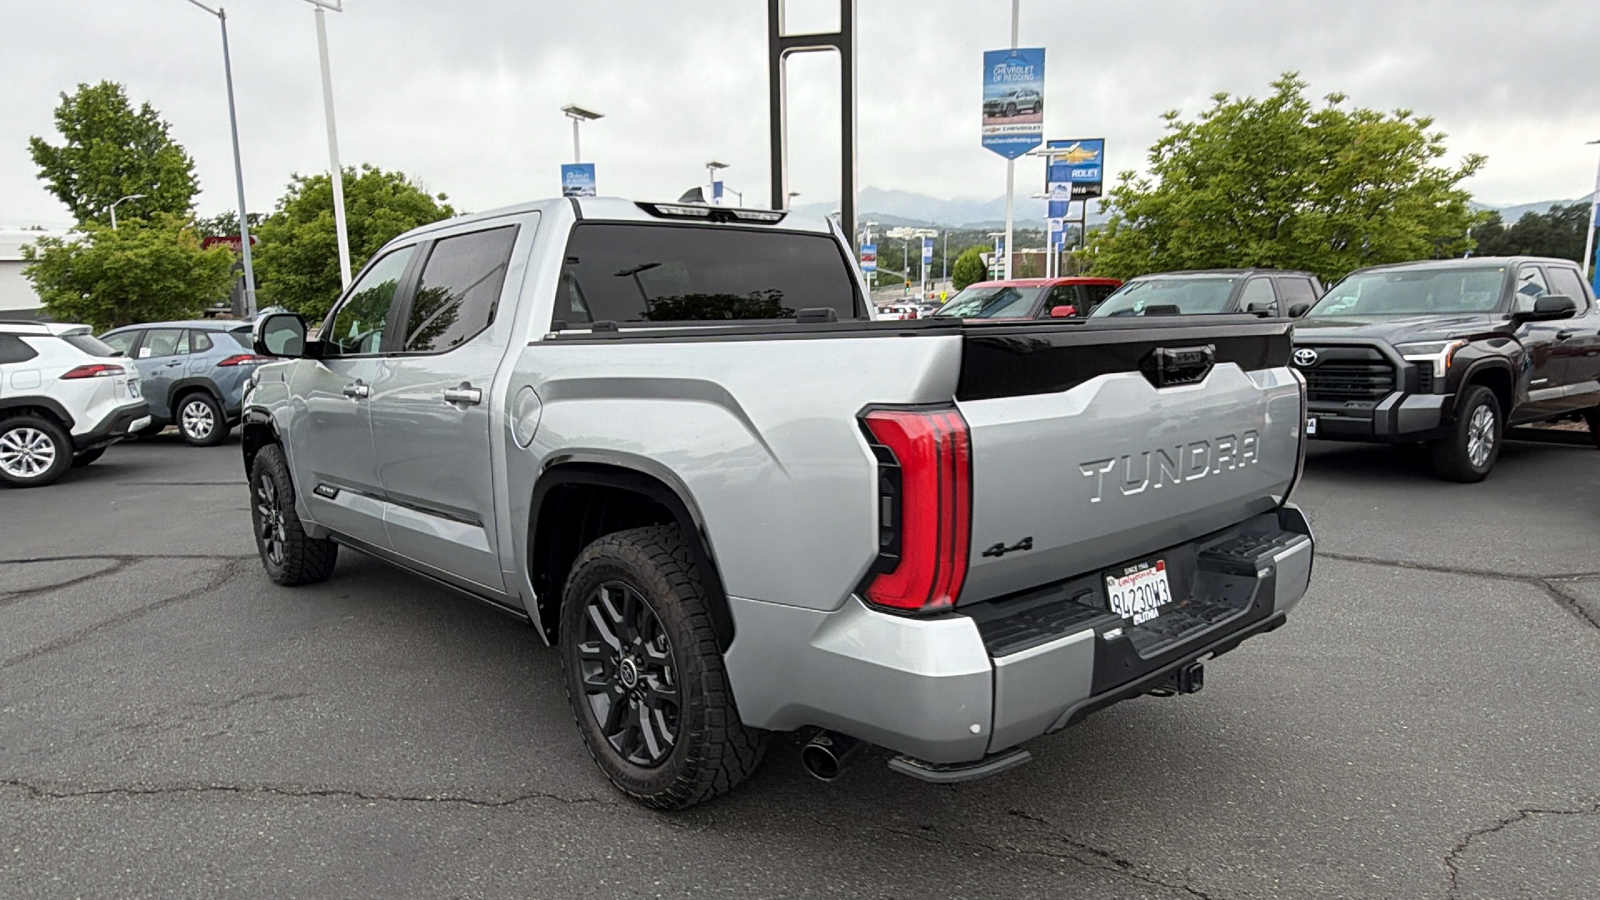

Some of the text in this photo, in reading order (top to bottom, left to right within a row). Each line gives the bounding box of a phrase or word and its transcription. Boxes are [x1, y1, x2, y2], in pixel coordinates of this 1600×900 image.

[993, 66, 1034, 76] CHEVROLET
[993, 73, 1034, 82] OF REDDING
[1071, 169, 1098, 178] ROLET
[1079, 429, 1259, 502] TUNDRA
[1124, 565, 1138, 575] SINCE
